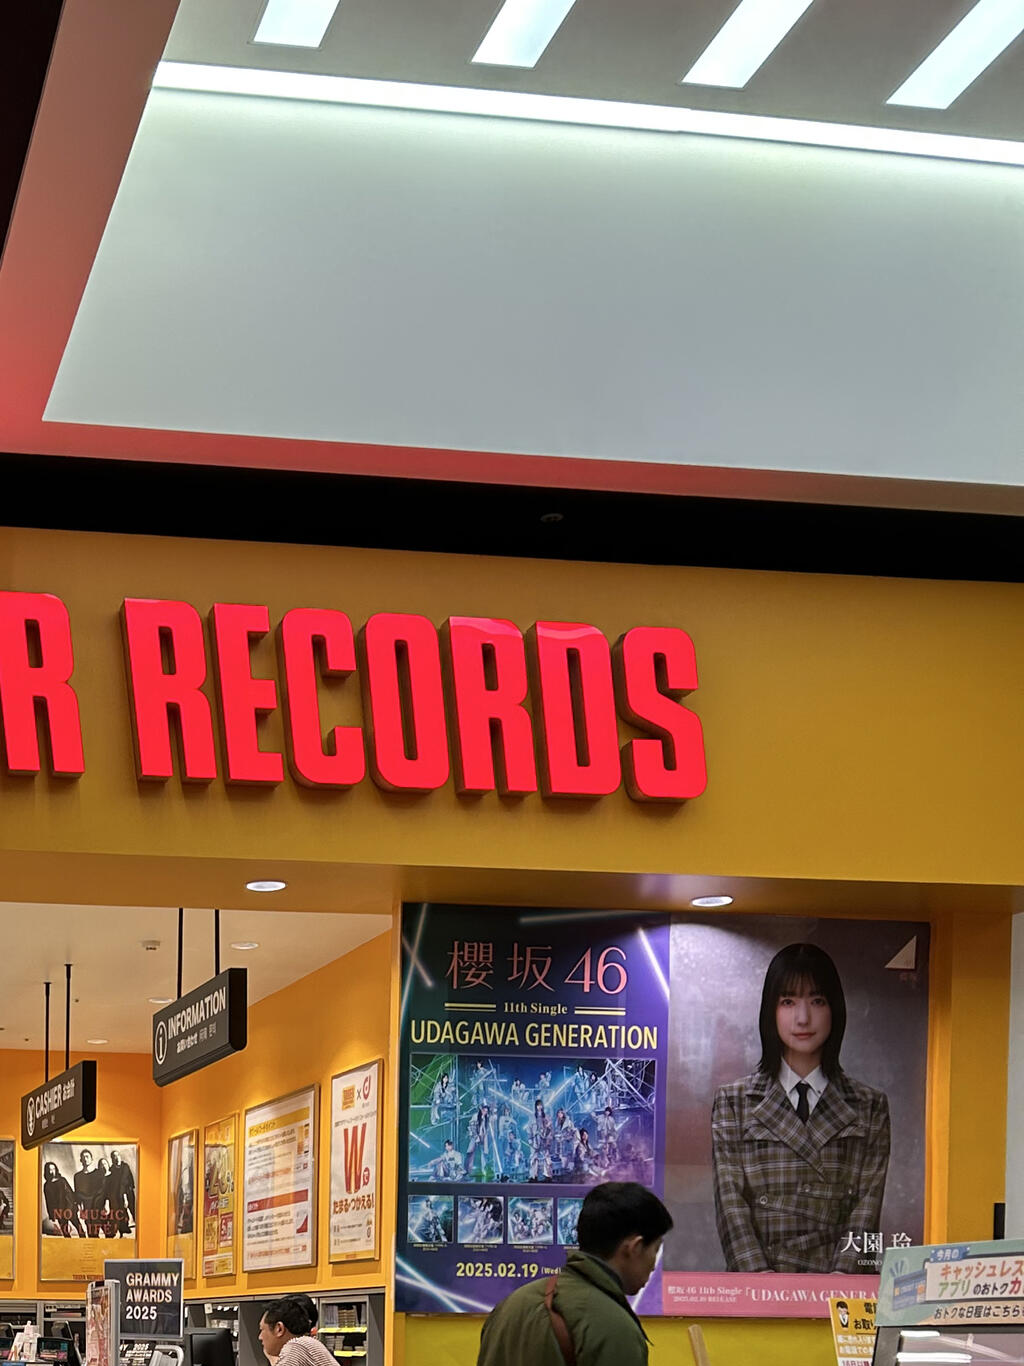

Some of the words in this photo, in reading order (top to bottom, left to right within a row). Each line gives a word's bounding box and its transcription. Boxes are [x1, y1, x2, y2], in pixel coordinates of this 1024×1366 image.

[120, 597, 709, 800] RECORDS
[446, 940, 628, 995] 櫻坂46
[168, 986, 226, 1040] INFORMATION
[504, 1002, 527, 1014] 11th
[530, 1003, 568, 1016] Single
[411, 1020, 519, 1046] UDAGAWA
[526, 1023, 658, 1050] GENERATION
[36, 1084, 63, 1119] CASHIER
[54, 1209, 73, 1220] NO
[53, 1223, 71, 1235] NO
[80, 1223, 118, 1235] LIFE!
[840, 1231, 883, 1254] 大園
[937, 1249, 959, 1260] 今月の
[456, 1262, 538, 1278] 2025.02.19
[941, 1259, 1024, 1280] キャッシュレス
[126, 1272, 180, 1288] GRAMMY
[126, 1288, 172, 1303] AWARDS
[820, 1289, 878, 1301] GENERA
[126, 1305, 157, 1320] 2025
[934, 1305, 1024, 1320] おトクな日程はこちら
